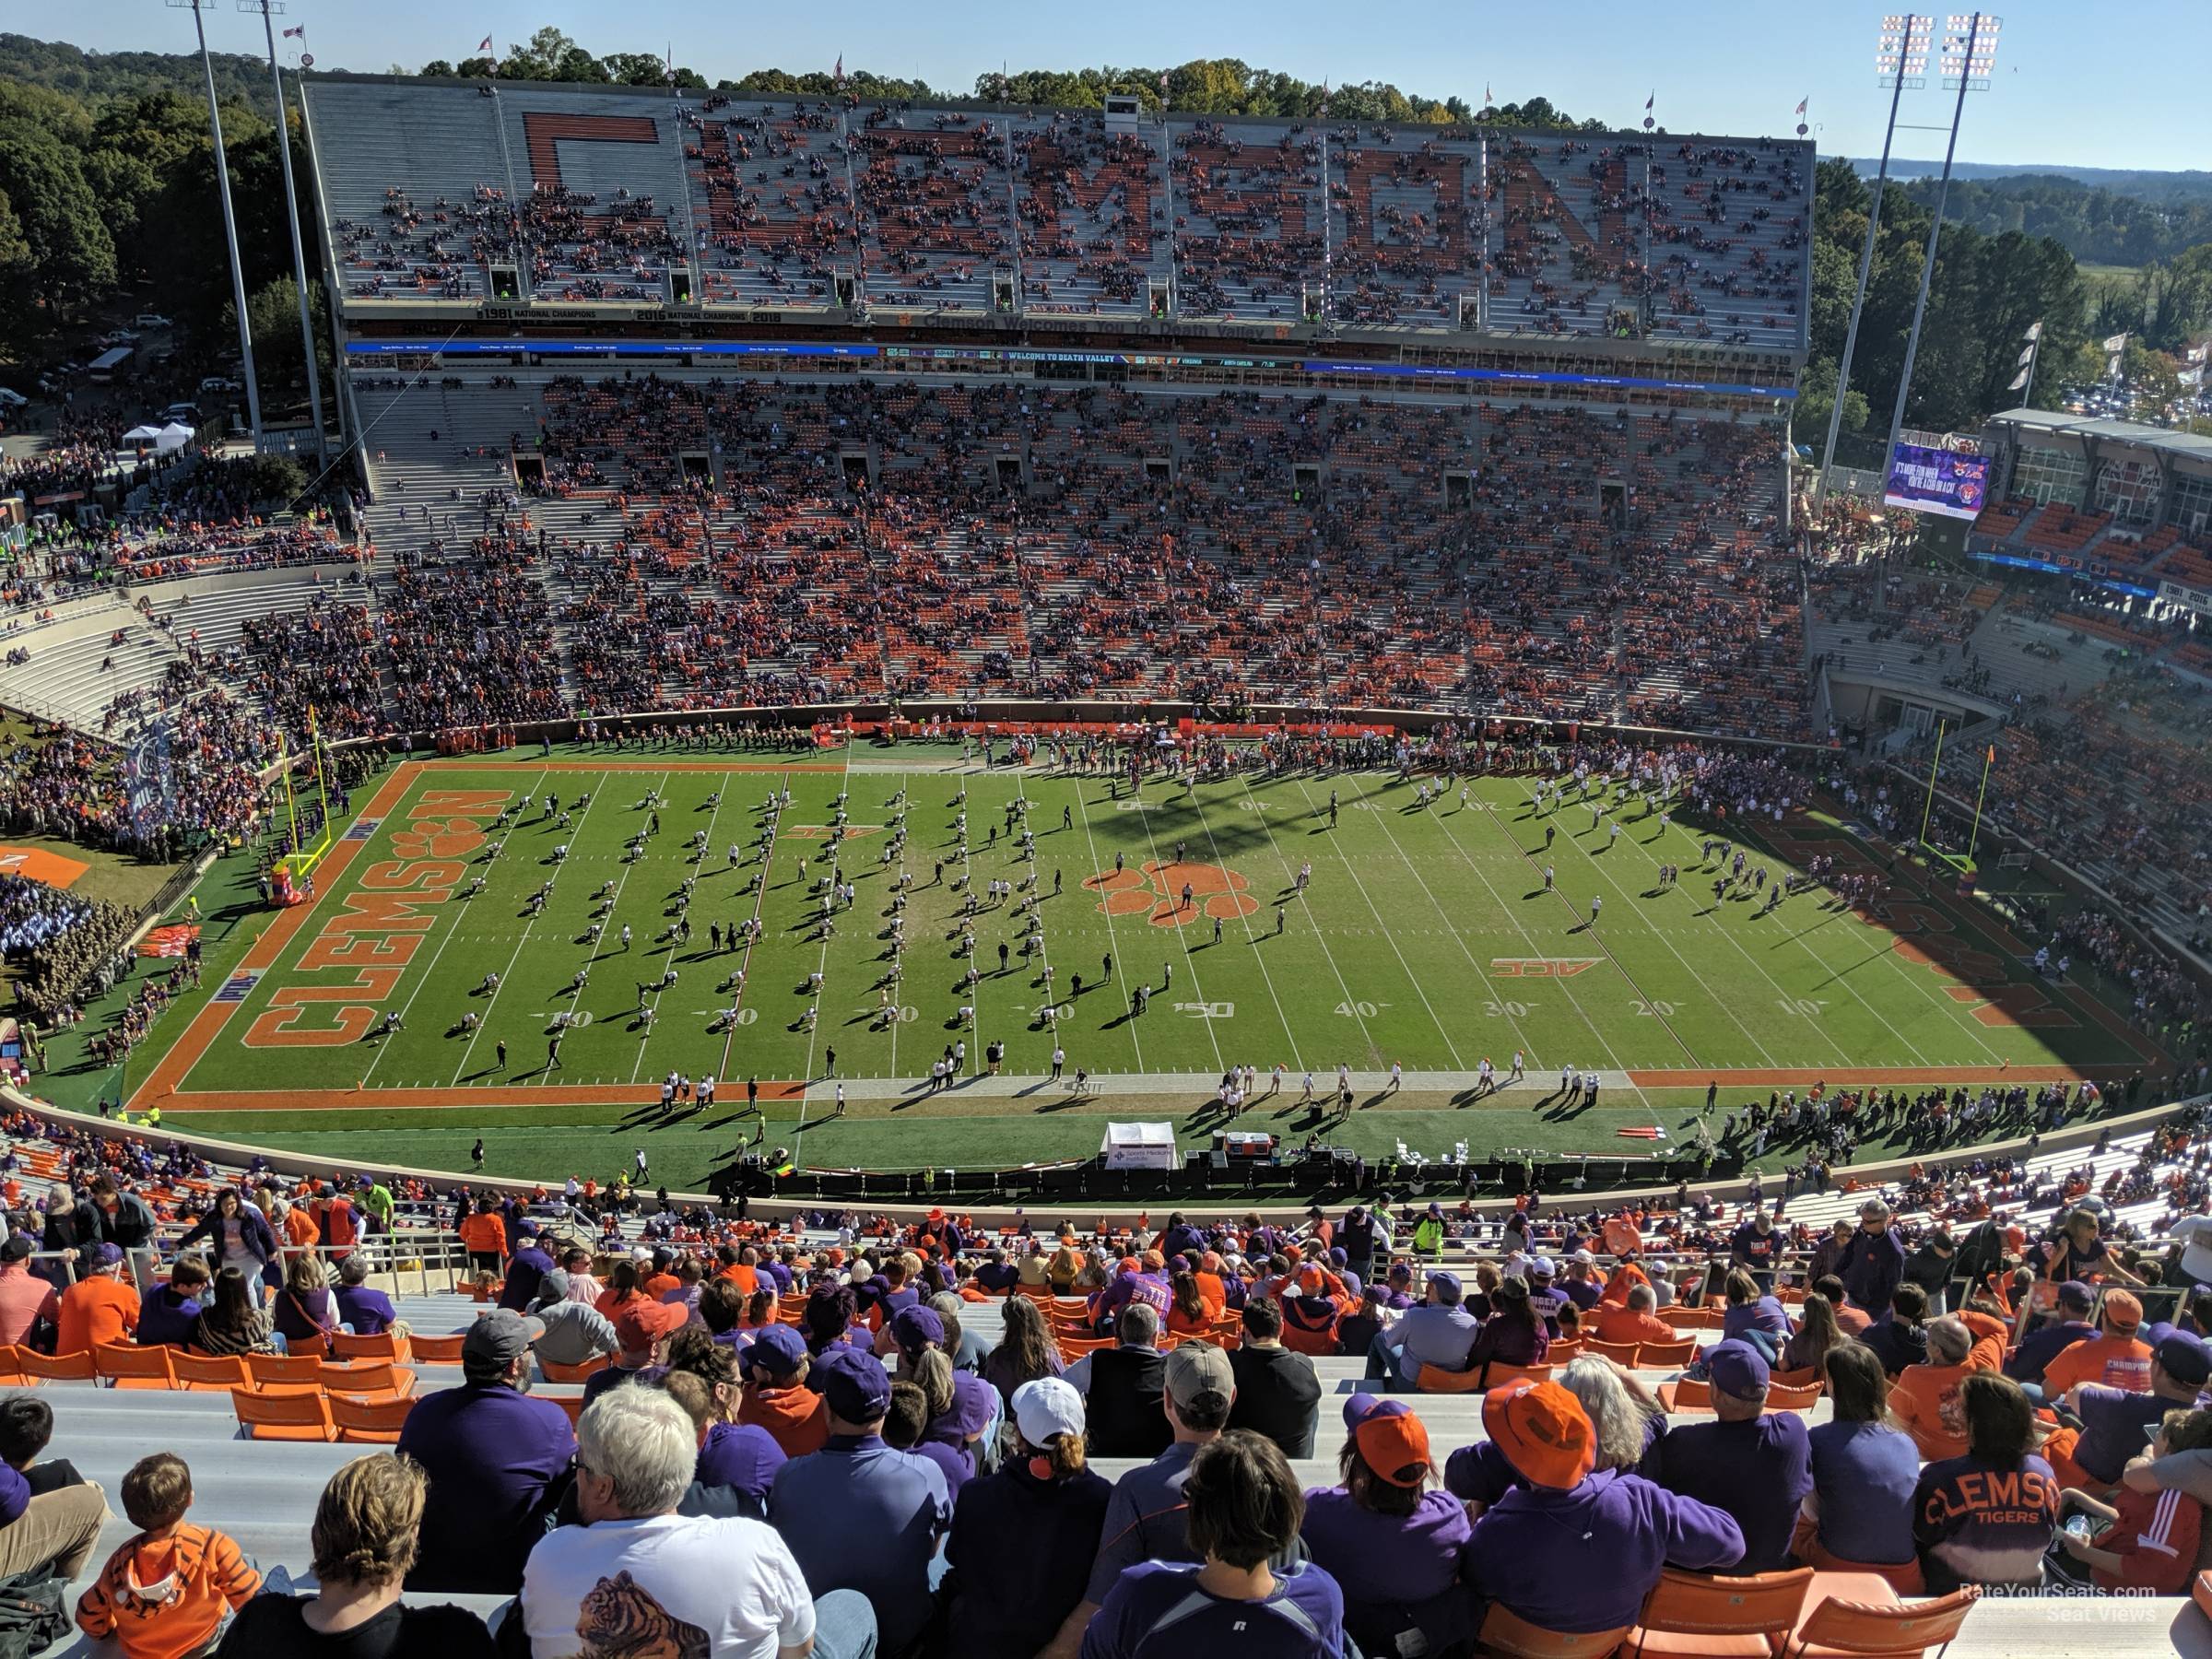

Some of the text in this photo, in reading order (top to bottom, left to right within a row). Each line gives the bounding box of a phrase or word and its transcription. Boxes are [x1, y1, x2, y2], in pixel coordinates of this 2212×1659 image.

[485, 308, 596, 319] 1981 NATIONAL CHAMPIONS
[667, 312, 701, 320] NATIONAL
[703, 312, 746, 321] CHAMPIONS
[924, 315, 1265, 339] Clemson Welcomes You To Death Valley
[1008, 351, 1045, 360] WELCOME
[1058, 353, 1084, 362] DEATH
[1085, 354, 1115, 362] VALLEY
[1907, 432, 1982, 455] CLEMSN
[2165, 583, 2208, 606] 1981 2016
[241, 790, 515, 1048] CLEMSN
[1334, 1001, 1378, 1018] 40
[1482, 1001, 1527, 1018] 30
[1629, 1000, 1675, 1017] 20
[1774, 999, 1820, 1015] 10
[1976, 1511, 2040, 1524] TIGERS
